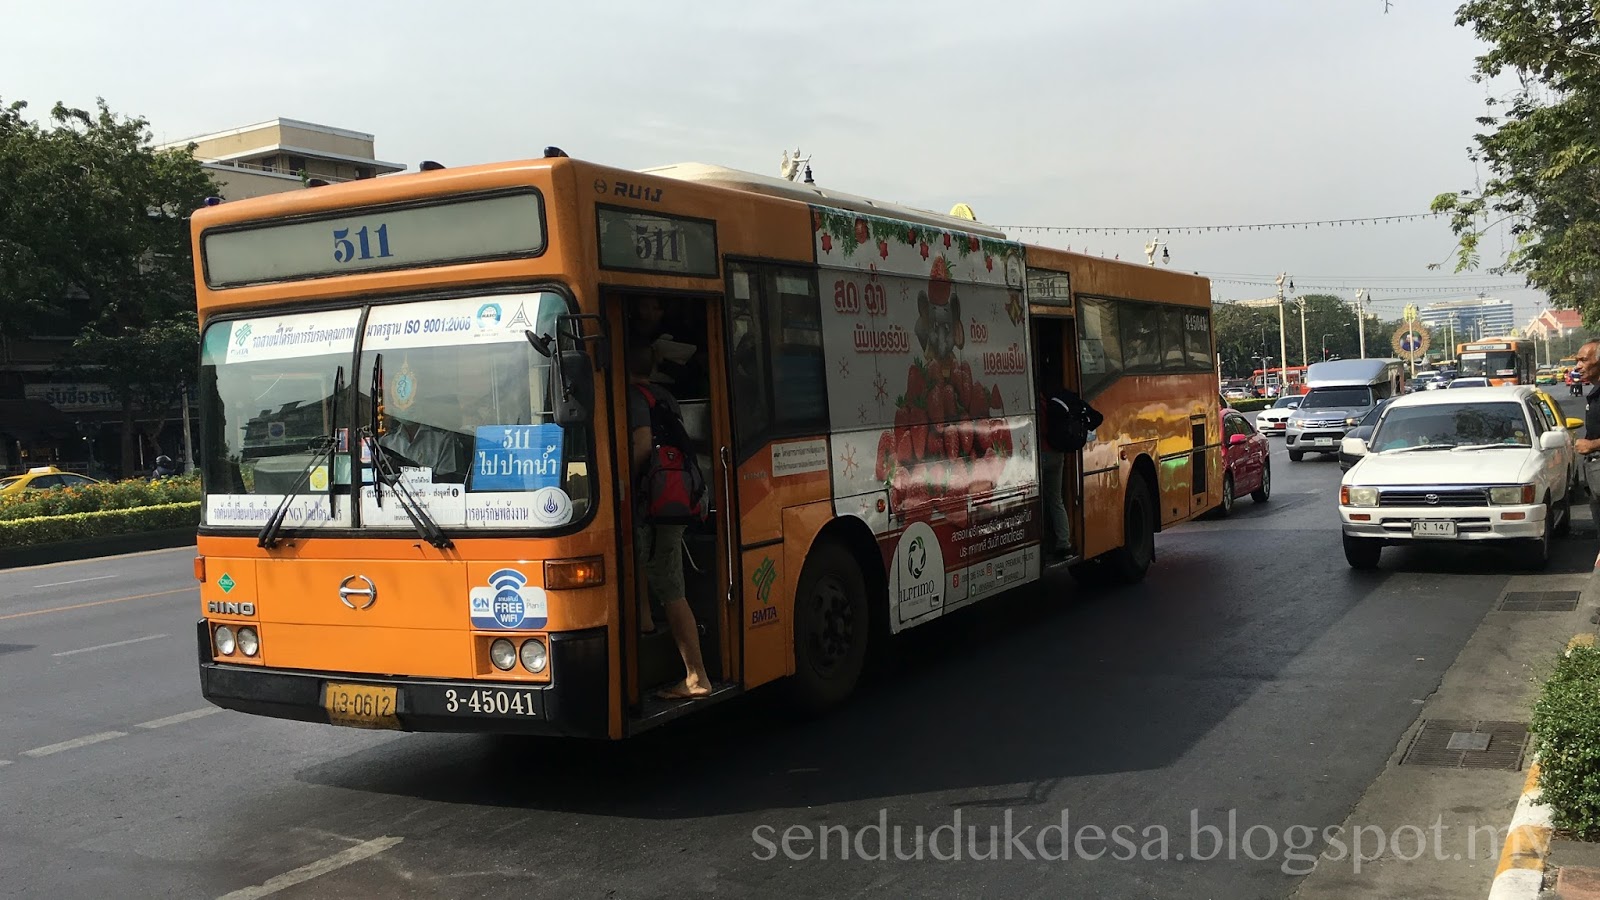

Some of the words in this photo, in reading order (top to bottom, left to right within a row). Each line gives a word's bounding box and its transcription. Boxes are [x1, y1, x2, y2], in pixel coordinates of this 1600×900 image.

[333, 223, 394, 263] 511
[635, 224, 682, 263] 511
[834, 279, 859, 313] สด
[367, 322, 402, 341] มาตรฐาน
[404, 319, 420, 335] ISO
[423, 316, 471, 335] 9001:2008
[502, 428, 530, 450] 511
[366, 489, 404, 498] สนมหลวง
[288, 507, 303, 521] NGV
[465, 501, 529, 527] ารอนุรักษ์พลังงาน
[1434, 522, 1450, 531] 147
[219, 578, 233, 586] CNG
[207, 600, 255, 616] HINO
[494, 602, 523, 613] FREE
[752, 606, 778, 625] BMTA
[331, 692, 392, 718] 13-0612
[445, 689, 537, 716] 3-45041
